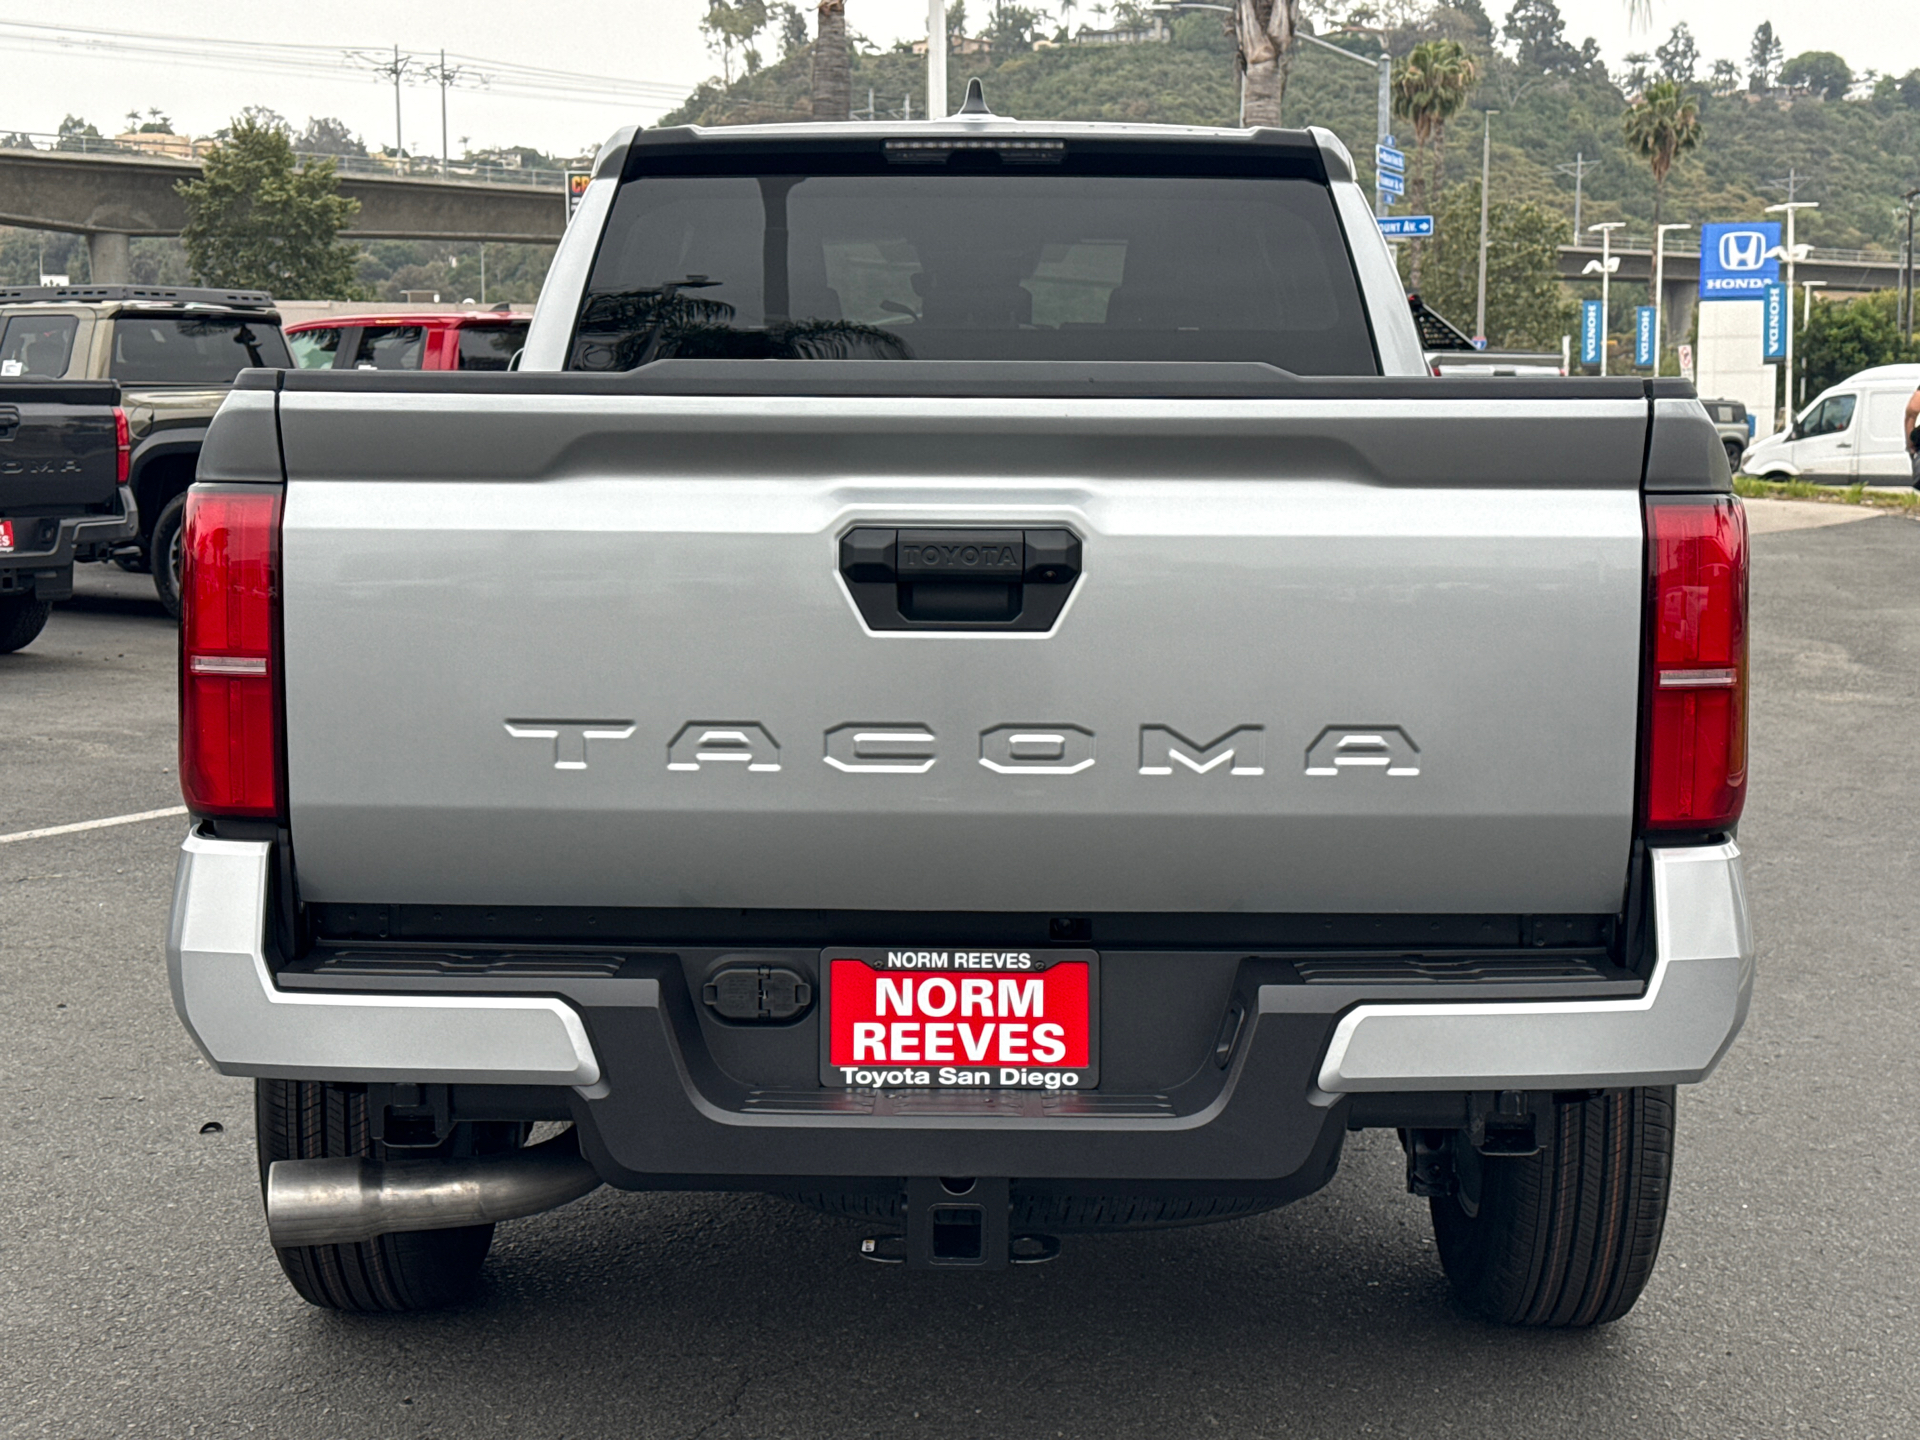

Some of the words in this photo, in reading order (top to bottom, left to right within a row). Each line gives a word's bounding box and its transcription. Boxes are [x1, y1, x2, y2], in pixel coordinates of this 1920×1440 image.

[1586, 305, 1597, 361] HONDA
[1641, 311, 1651, 363] HONDA
[1769, 288, 1780, 355] HONDA
[904, 546, 1017, 566] TOYOTA
[504, 718, 1421, 776] TACOMA
[887, 952, 948, 968] NORM
[954, 953, 1031, 968] REEVES
[875, 977, 1044, 1017] NORM
[853, 1022, 1066, 1062] REEVES
[840, 1067, 930, 1088] Toyota
[938, 1068, 990, 1085] San
[1000, 1069, 1079, 1089] Diego
